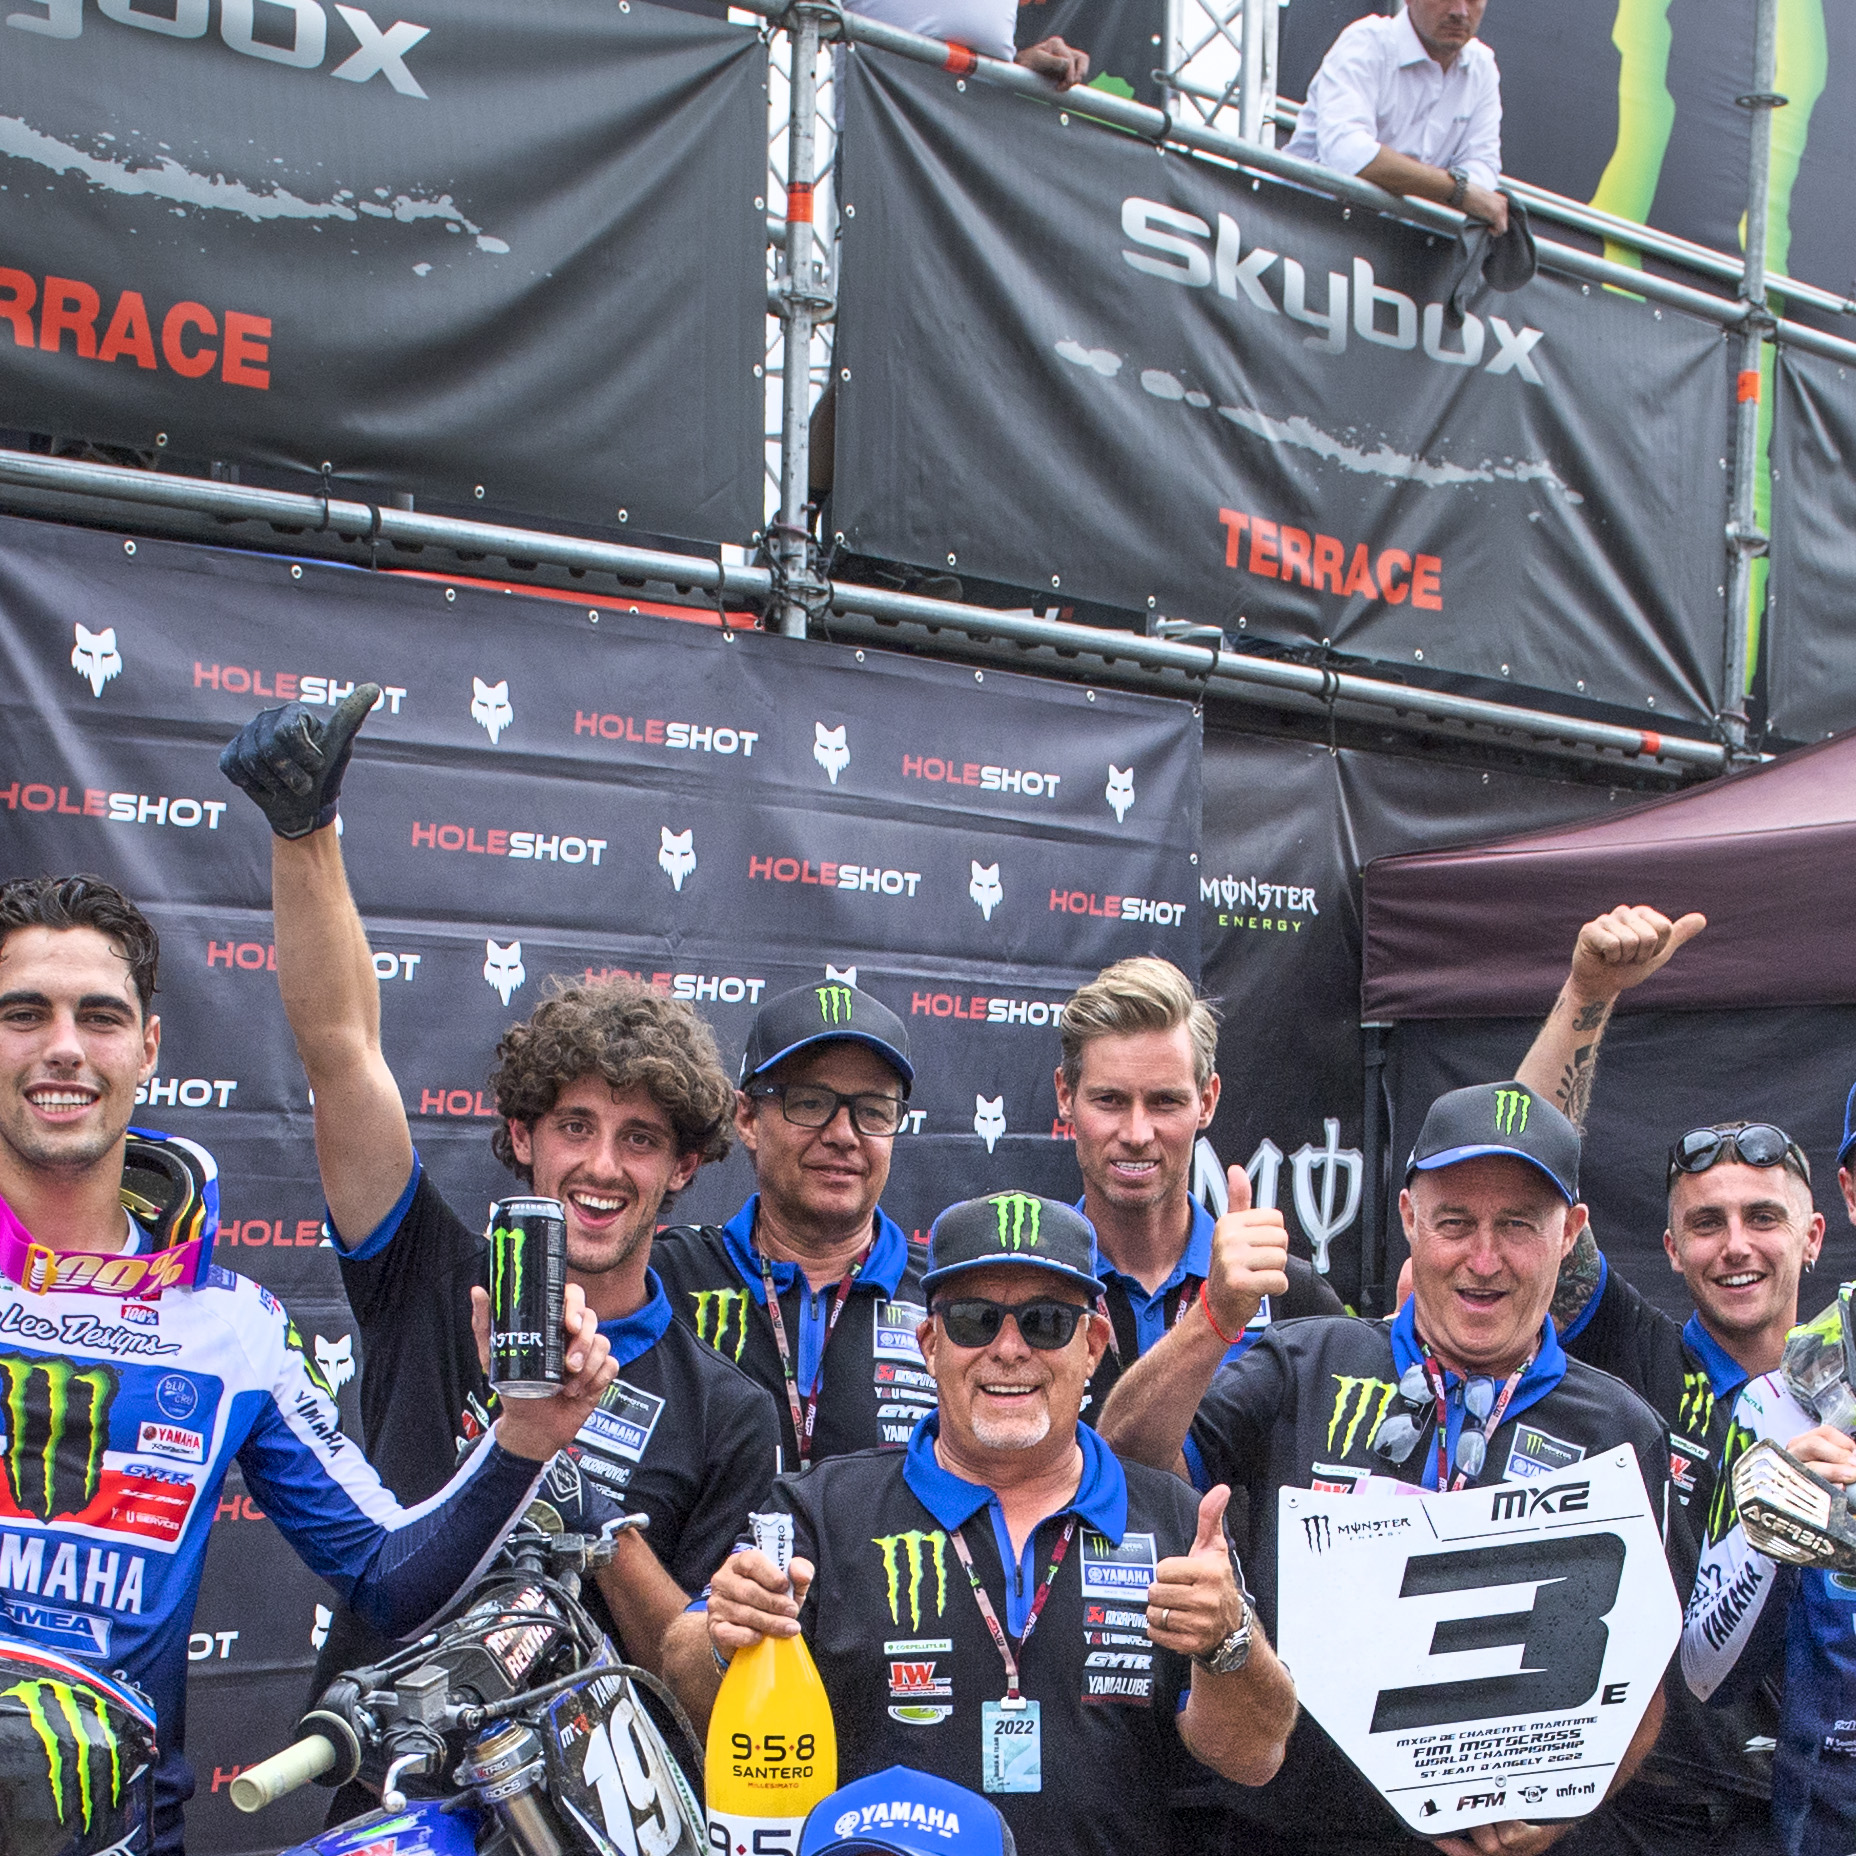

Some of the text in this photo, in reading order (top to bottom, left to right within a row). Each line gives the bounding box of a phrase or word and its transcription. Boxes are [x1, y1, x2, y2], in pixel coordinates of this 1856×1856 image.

[1219, 509, 1443, 611] TERRACE
[575, 711, 758, 756] HOLESHOT
[903, 754, 1060, 798] HOLESHOT
[412, 822, 606, 866] HOLESHOT
[749, 856, 921, 897] HOLESHOT
[1050, 889, 1186, 928] HOLESHOT
[1200, 875, 1319, 914] MONSTER
[1219, 916, 1303, 932] ENERGY
[913, 994, 1063, 1026] HOLESHOT
[0, 1304, 57, 1338] Lee
[58, 1316, 181, 1355] Designs
[123, 1306, 158, 1324] 100%
[159, 1428, 200, 1448] YAMAHA
[595, 1416, 641, 1446] YAMAHA
[122, 1464, 193, 1486] GYTR
[1492, 1481, 1590, 1522] MX2
[1742, 1507, 1835, 1557] ACERBIS
[1102, 1570, 1150, 1584] YAMAHA
[1703, 1562, 1760, 1650] YAMAHA
[1370, 1532, 1626, 1734] 3
[1085, 1652, 1152, 1669] GYTR
[1088, 1676, 1150, 1696] YAMALUBE
[1601, 1681, 1630, 1706] E
[995, 1720, 1034, 1734] 2022
[1397, 1736, 1436, 1747] MXGP
[1459, 1725, 1526, 1739] CHARENTE
[1531, 1717, 1598, 1730] MARITIME
[1413, 1728, 1581, 1758] FIM MOTOCROSS
[1415, 1740, 1585, 1767] WORLD CHAMPIONSHIP
[733, 1766, 813, 1779] SANTERO
[1420, 1753, 1582, 1779] ST-JEAN D'ANGELY 2022
[1457, 1792, 1506, 1811] FFM
[860, 1801, 959, 1834] YAMAHA
